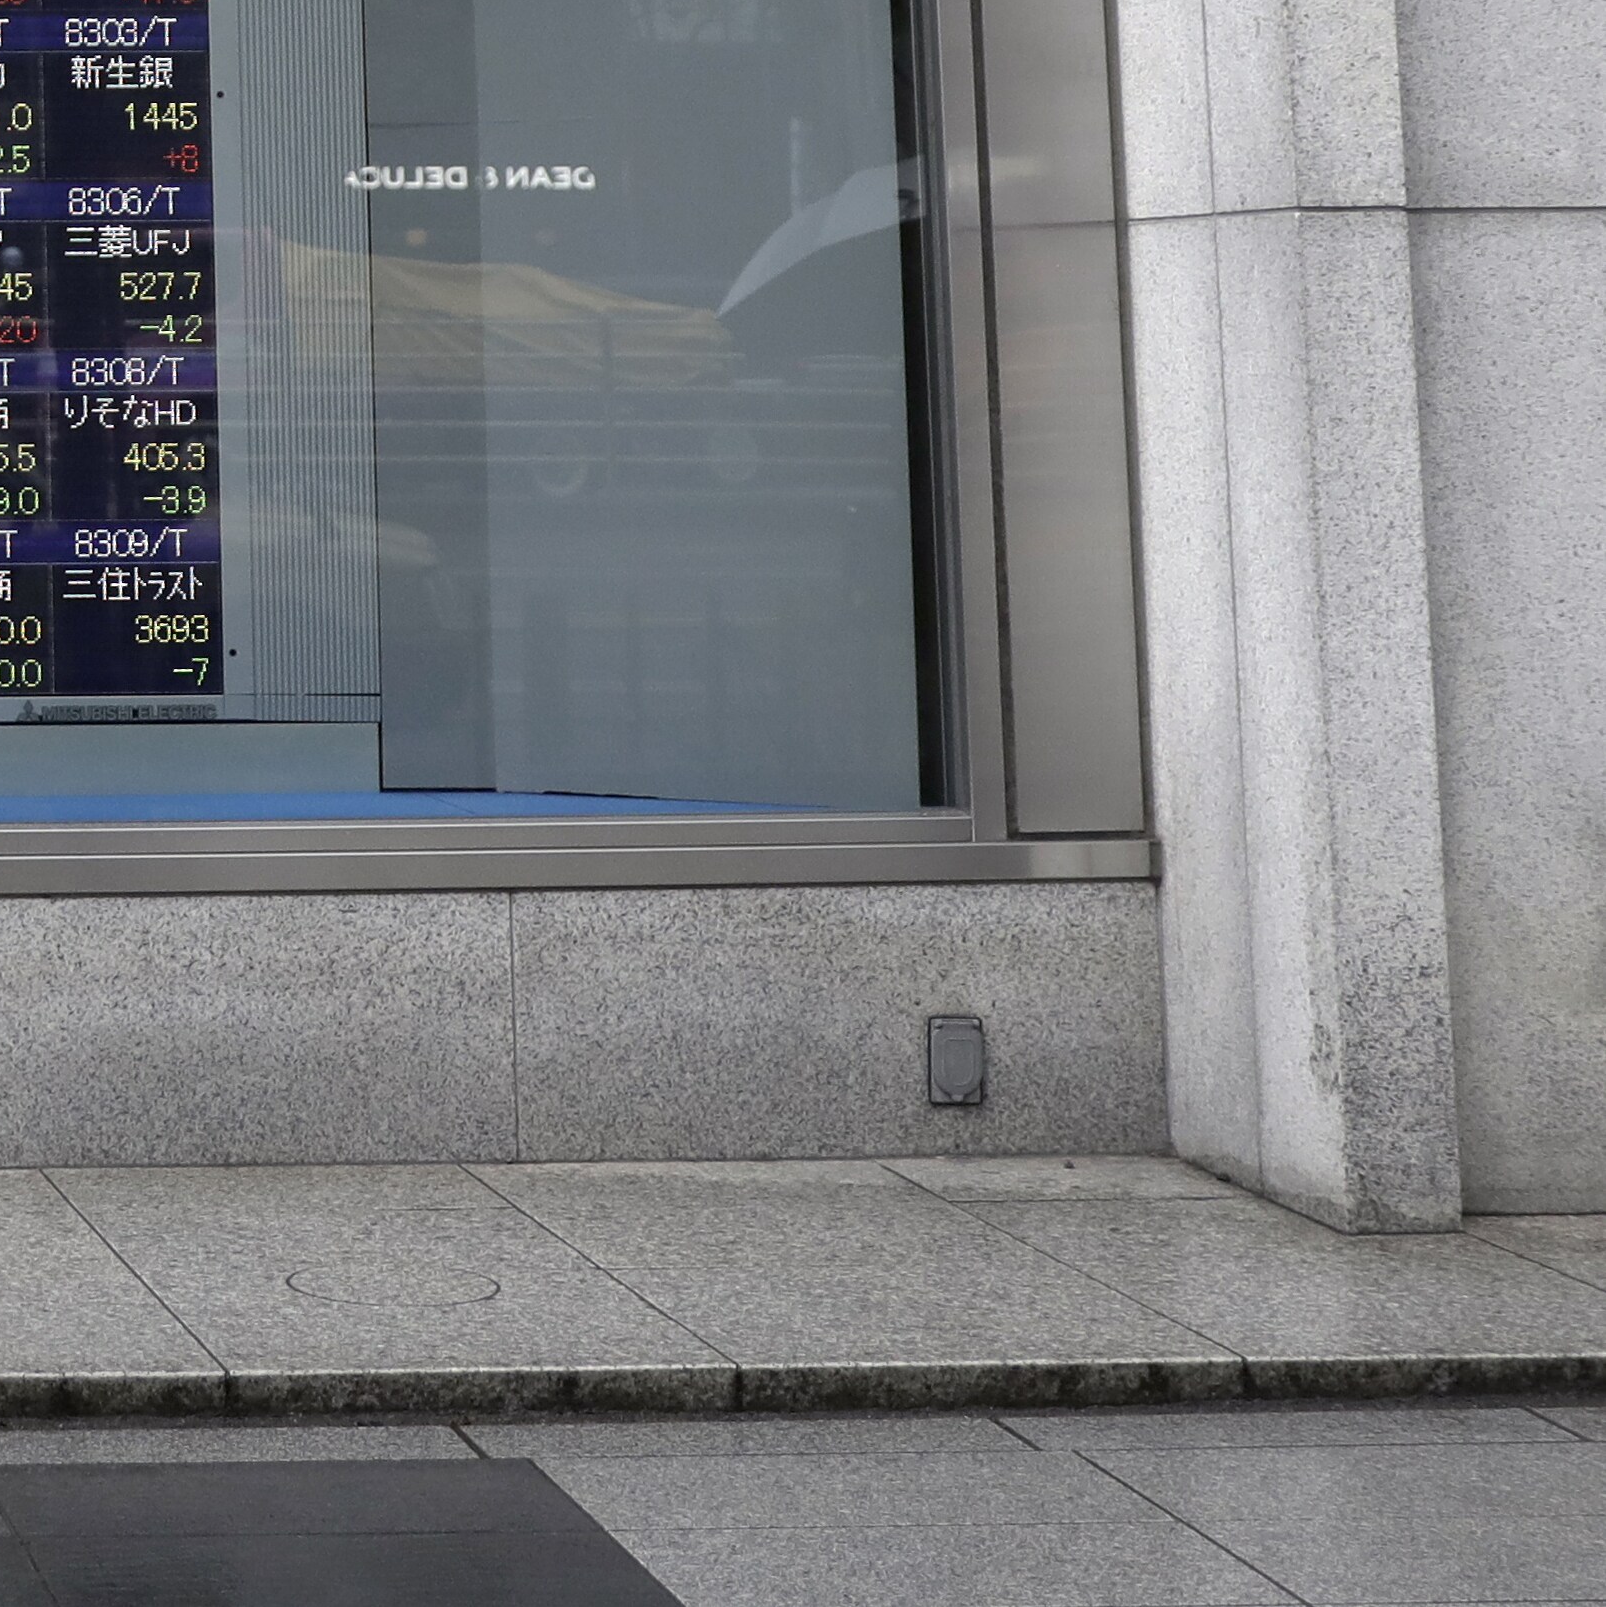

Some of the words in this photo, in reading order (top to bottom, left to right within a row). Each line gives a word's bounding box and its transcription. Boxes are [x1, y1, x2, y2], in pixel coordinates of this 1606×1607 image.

[70, 54, 174, 89] 新生銀
[124, 102, 198, 131] 1445
[64, 224, 191, 259] 三菱UFJ
[64, 394, 197, 429] りそなHD
[62, 565, 203, 601] 三住トラスト
[134, 614, 209, 644] 3693
[40, 704, 134, 721] MITSUBISHI
[137, 704, 218, 720] ELECTRIC
